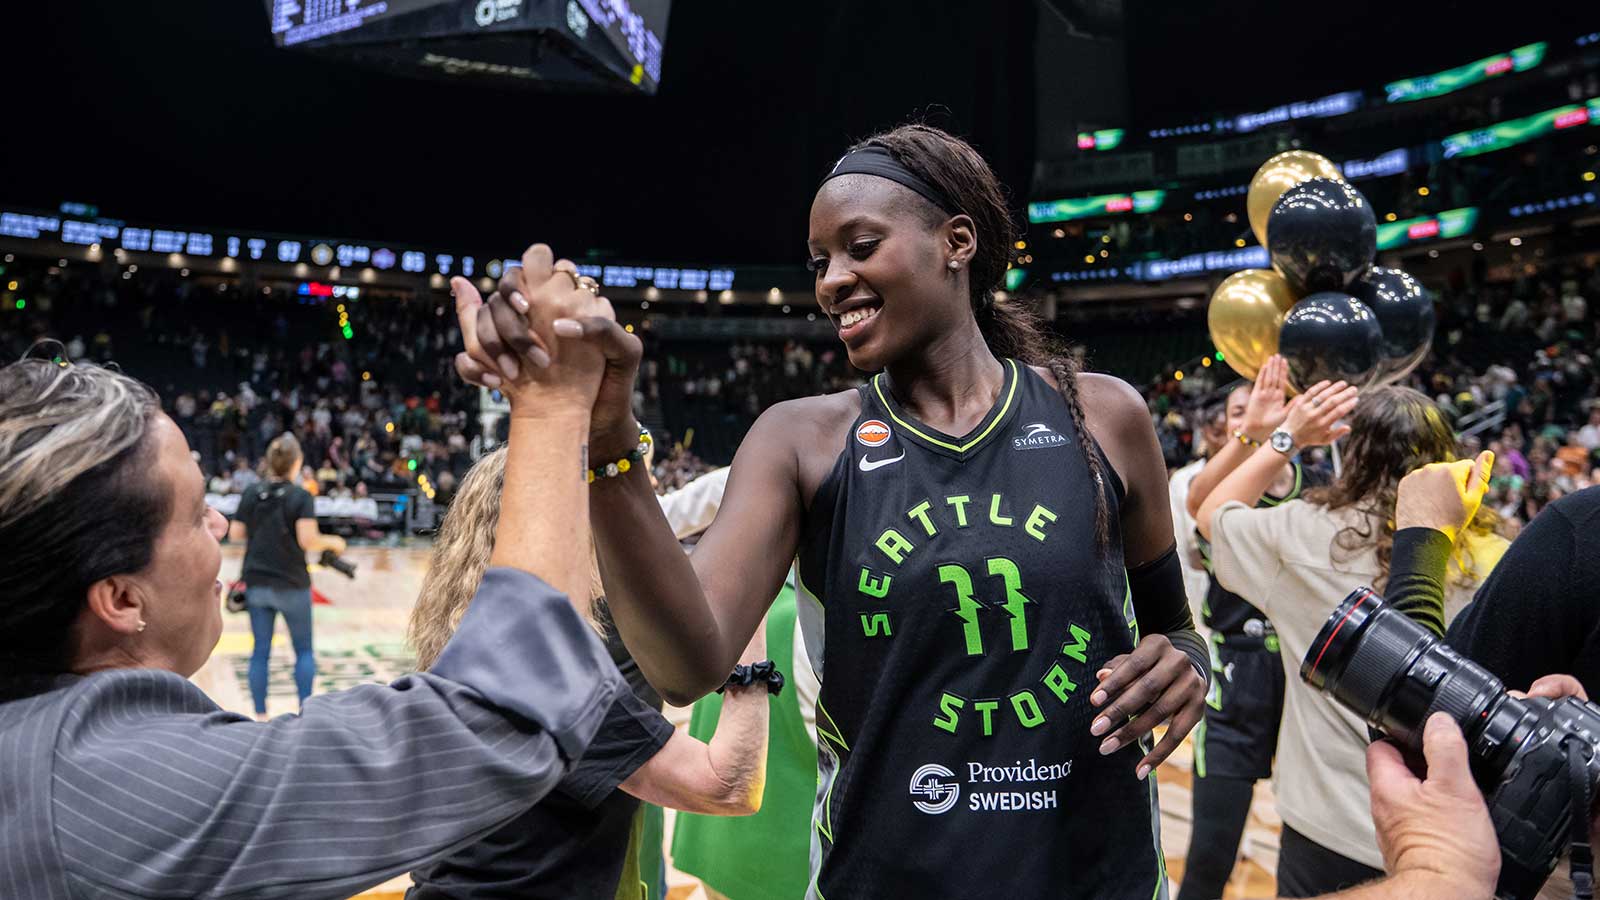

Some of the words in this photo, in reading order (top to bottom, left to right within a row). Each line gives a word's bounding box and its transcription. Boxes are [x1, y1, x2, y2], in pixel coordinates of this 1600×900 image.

[1014, 434, 1066, 448] SYMETRA
[859, 493, 1058, 638] SEATTLE
[937, 556, 1030, 656] 11
[932, 622, 1092, 737] STORM
[969, 790, 1057, 812] SWEDISH
